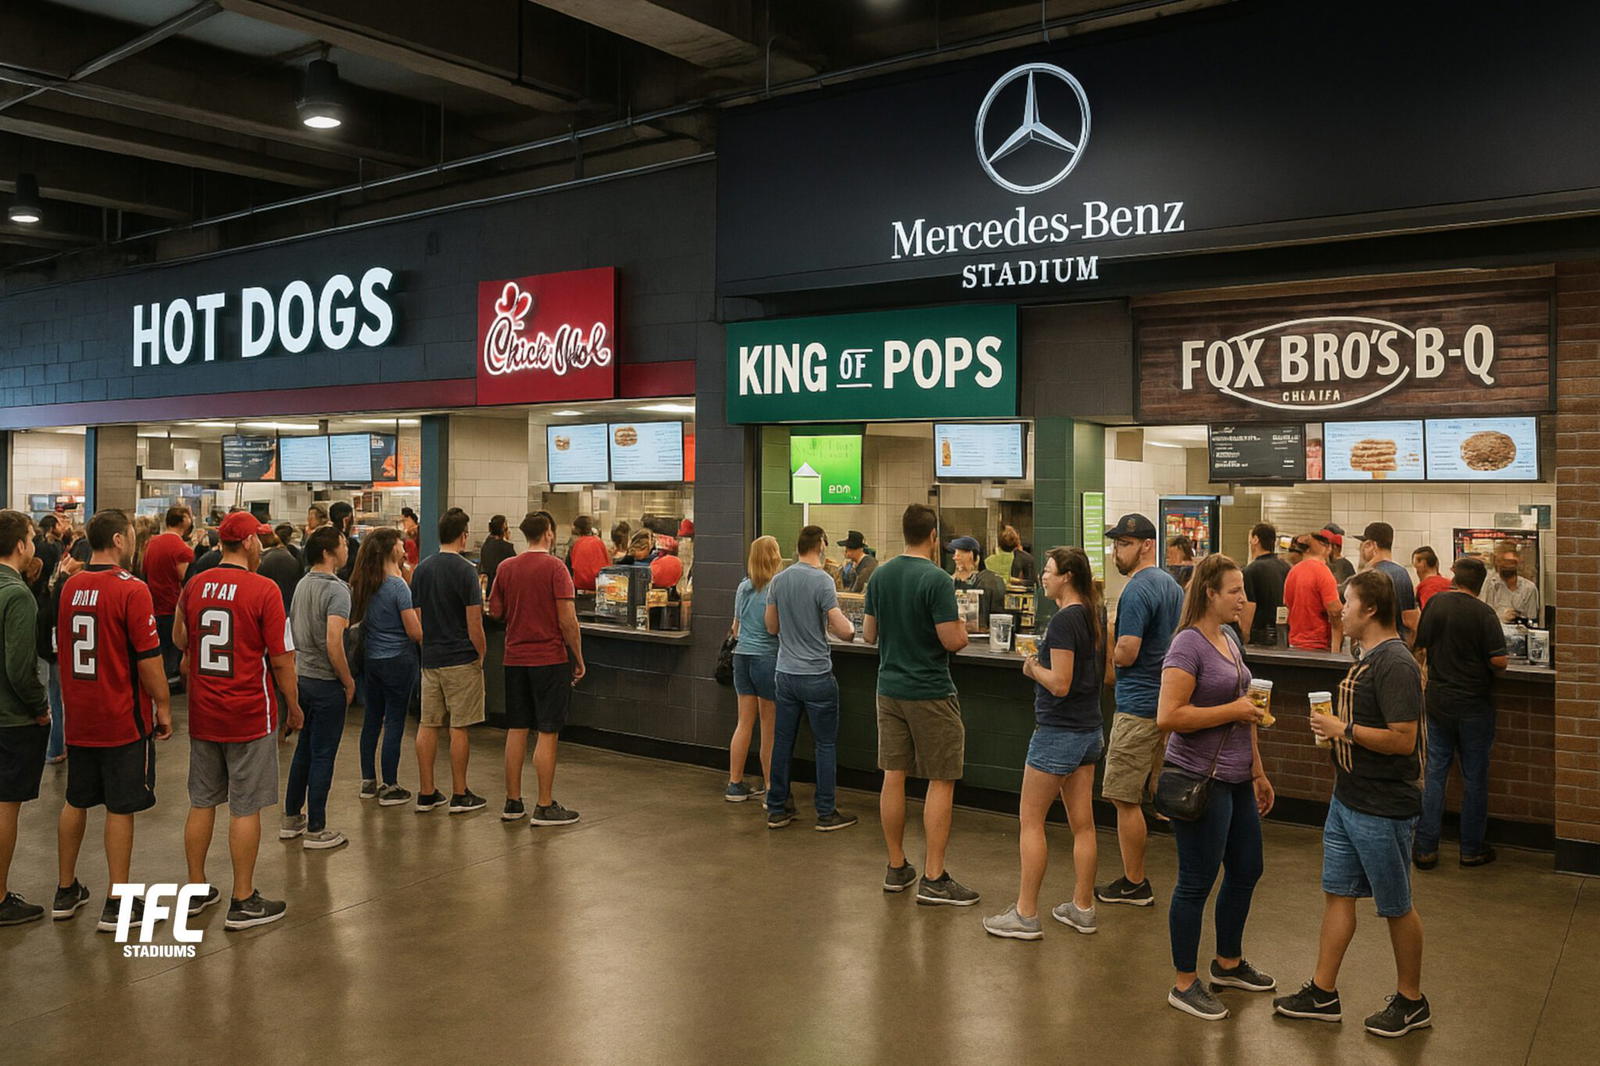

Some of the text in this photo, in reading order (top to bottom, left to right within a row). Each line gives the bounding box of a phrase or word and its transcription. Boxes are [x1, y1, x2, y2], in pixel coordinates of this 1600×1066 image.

[891, 200, 1186, 259] Mercedes-Benz
[961, 255, 1100, 289] STADIUM
[132, 266, 394, 368] HOT DOGS
[738, 335, 1003, 396] KING OF POPS
[1181, 323, 1496, 391] FOX BRO'S B-Q
[201, 582, 238, 601] RYAN
[71, 614, 97, 676] 2
[201, 609, 231, 673] 2
